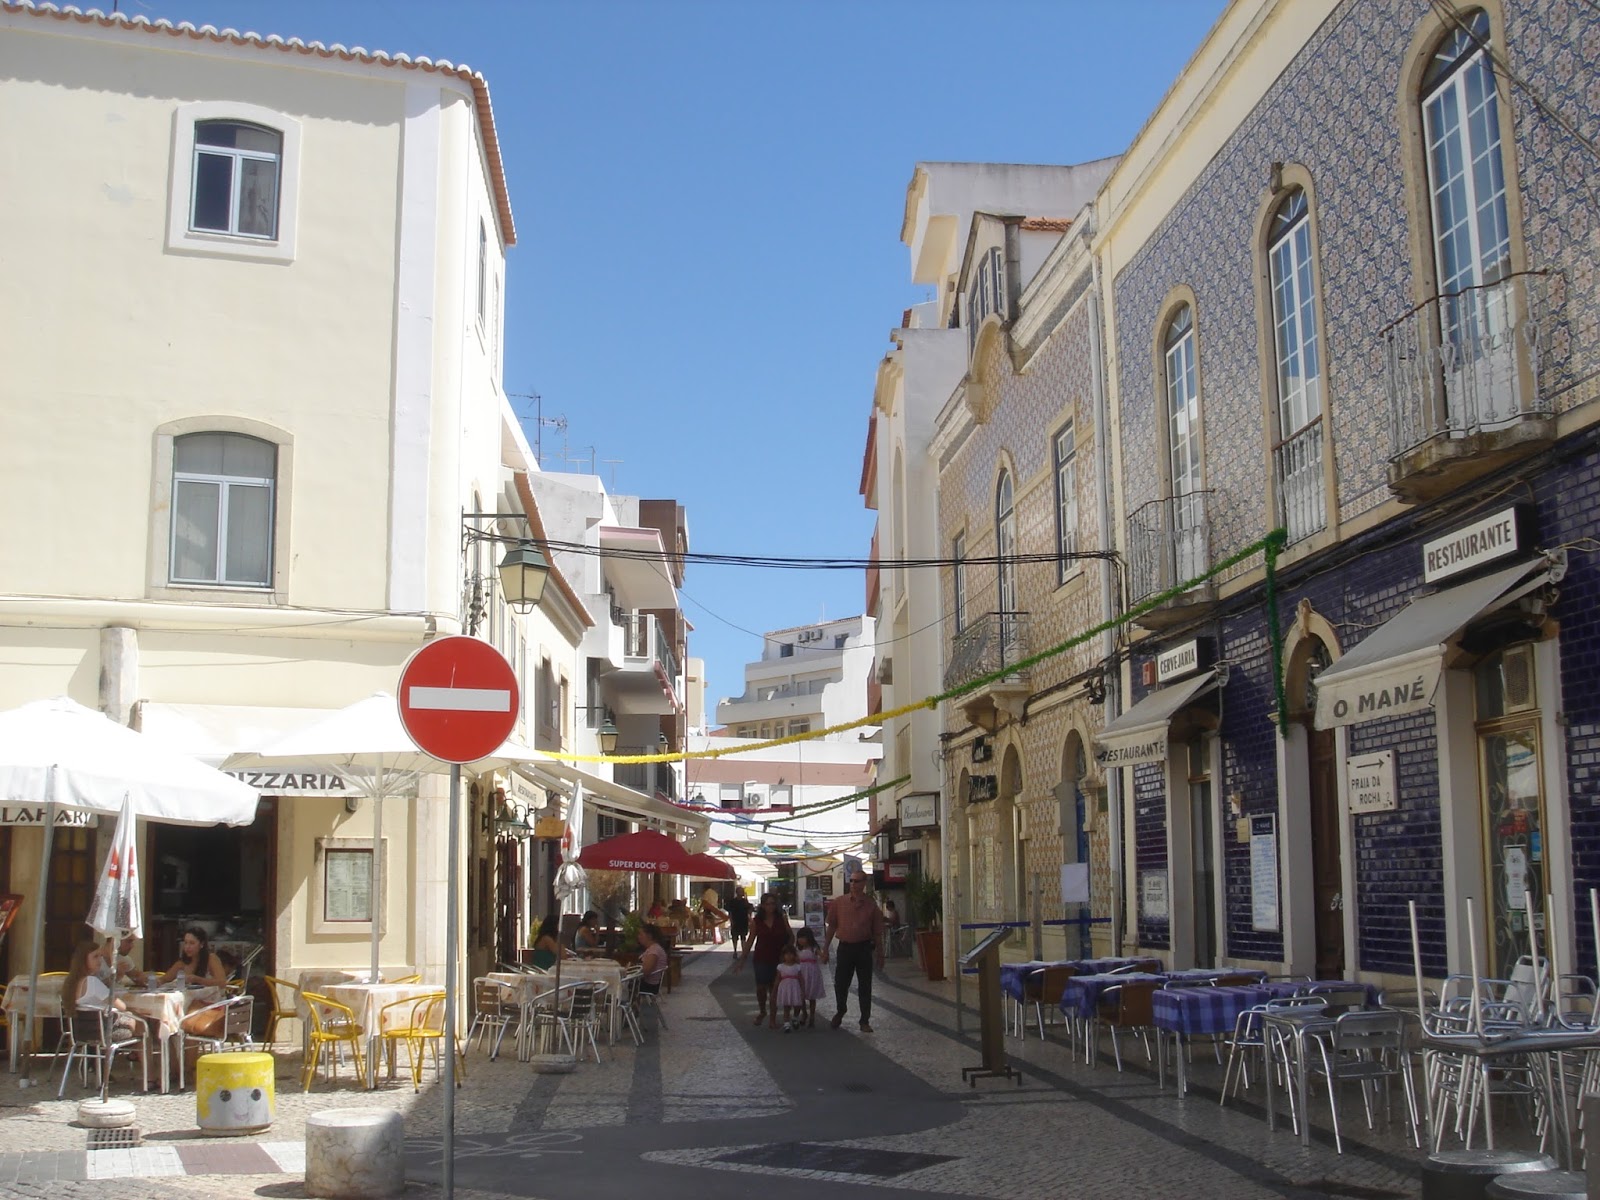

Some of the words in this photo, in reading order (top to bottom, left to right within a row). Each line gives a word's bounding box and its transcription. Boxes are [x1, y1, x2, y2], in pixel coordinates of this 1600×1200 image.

[1427, 519, 1512, 573] RESTAURANTE
[1160, 648, 1196, 675] CERVEJARIA
[1333, 699, 1348, 718] O
[1358, 675, 1425, 713] MANÉ
[1098, 740, 1165, 762] RESTAURANTE
[1351, 776, 1370, 790] PRAIA
[1371, 775, 1381, 787] DA
[1359, 791, 1381, 805] ROCHA
[608, 859, 634, 869] SUPER
[634, 861, 657, 870] BOCK
